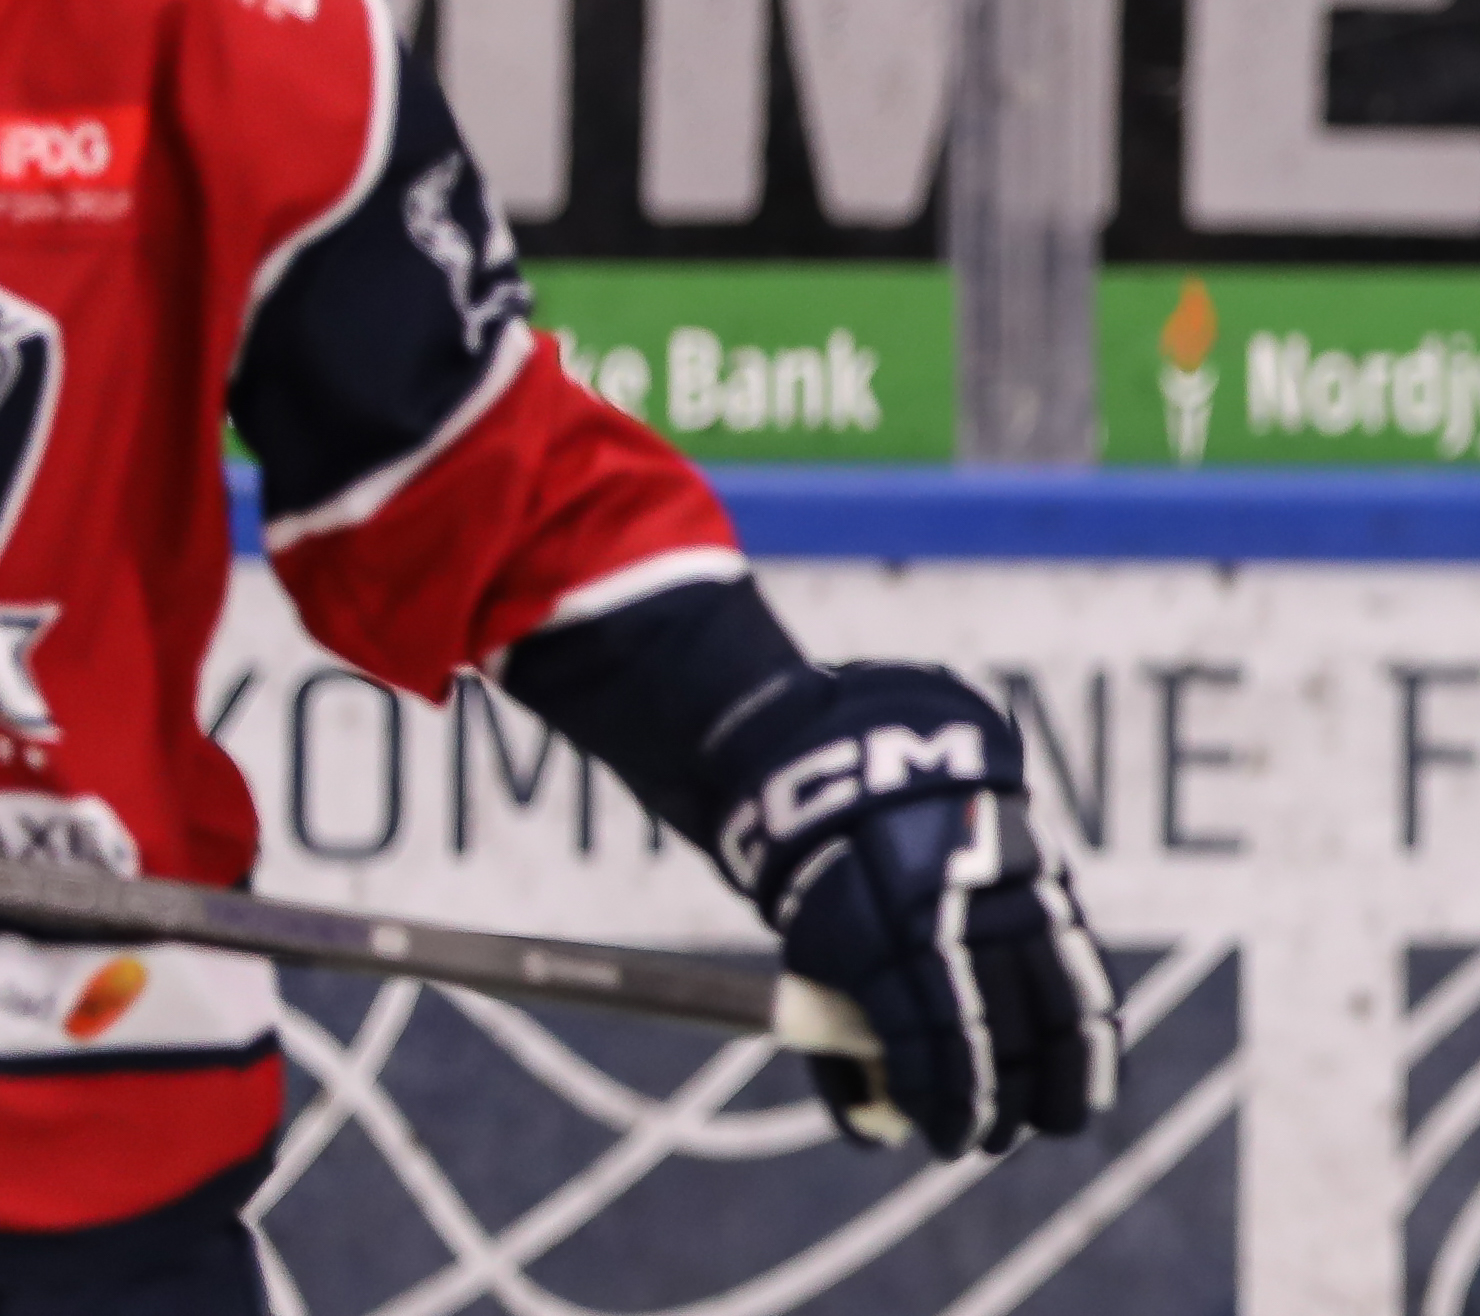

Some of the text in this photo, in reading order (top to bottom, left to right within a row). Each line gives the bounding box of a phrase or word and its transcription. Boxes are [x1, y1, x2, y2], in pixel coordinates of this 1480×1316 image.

[665, 324, 881, 432] Bank
[205, 660, 1247, 859] OMNE
[719, 722, 988, 886] CCM
